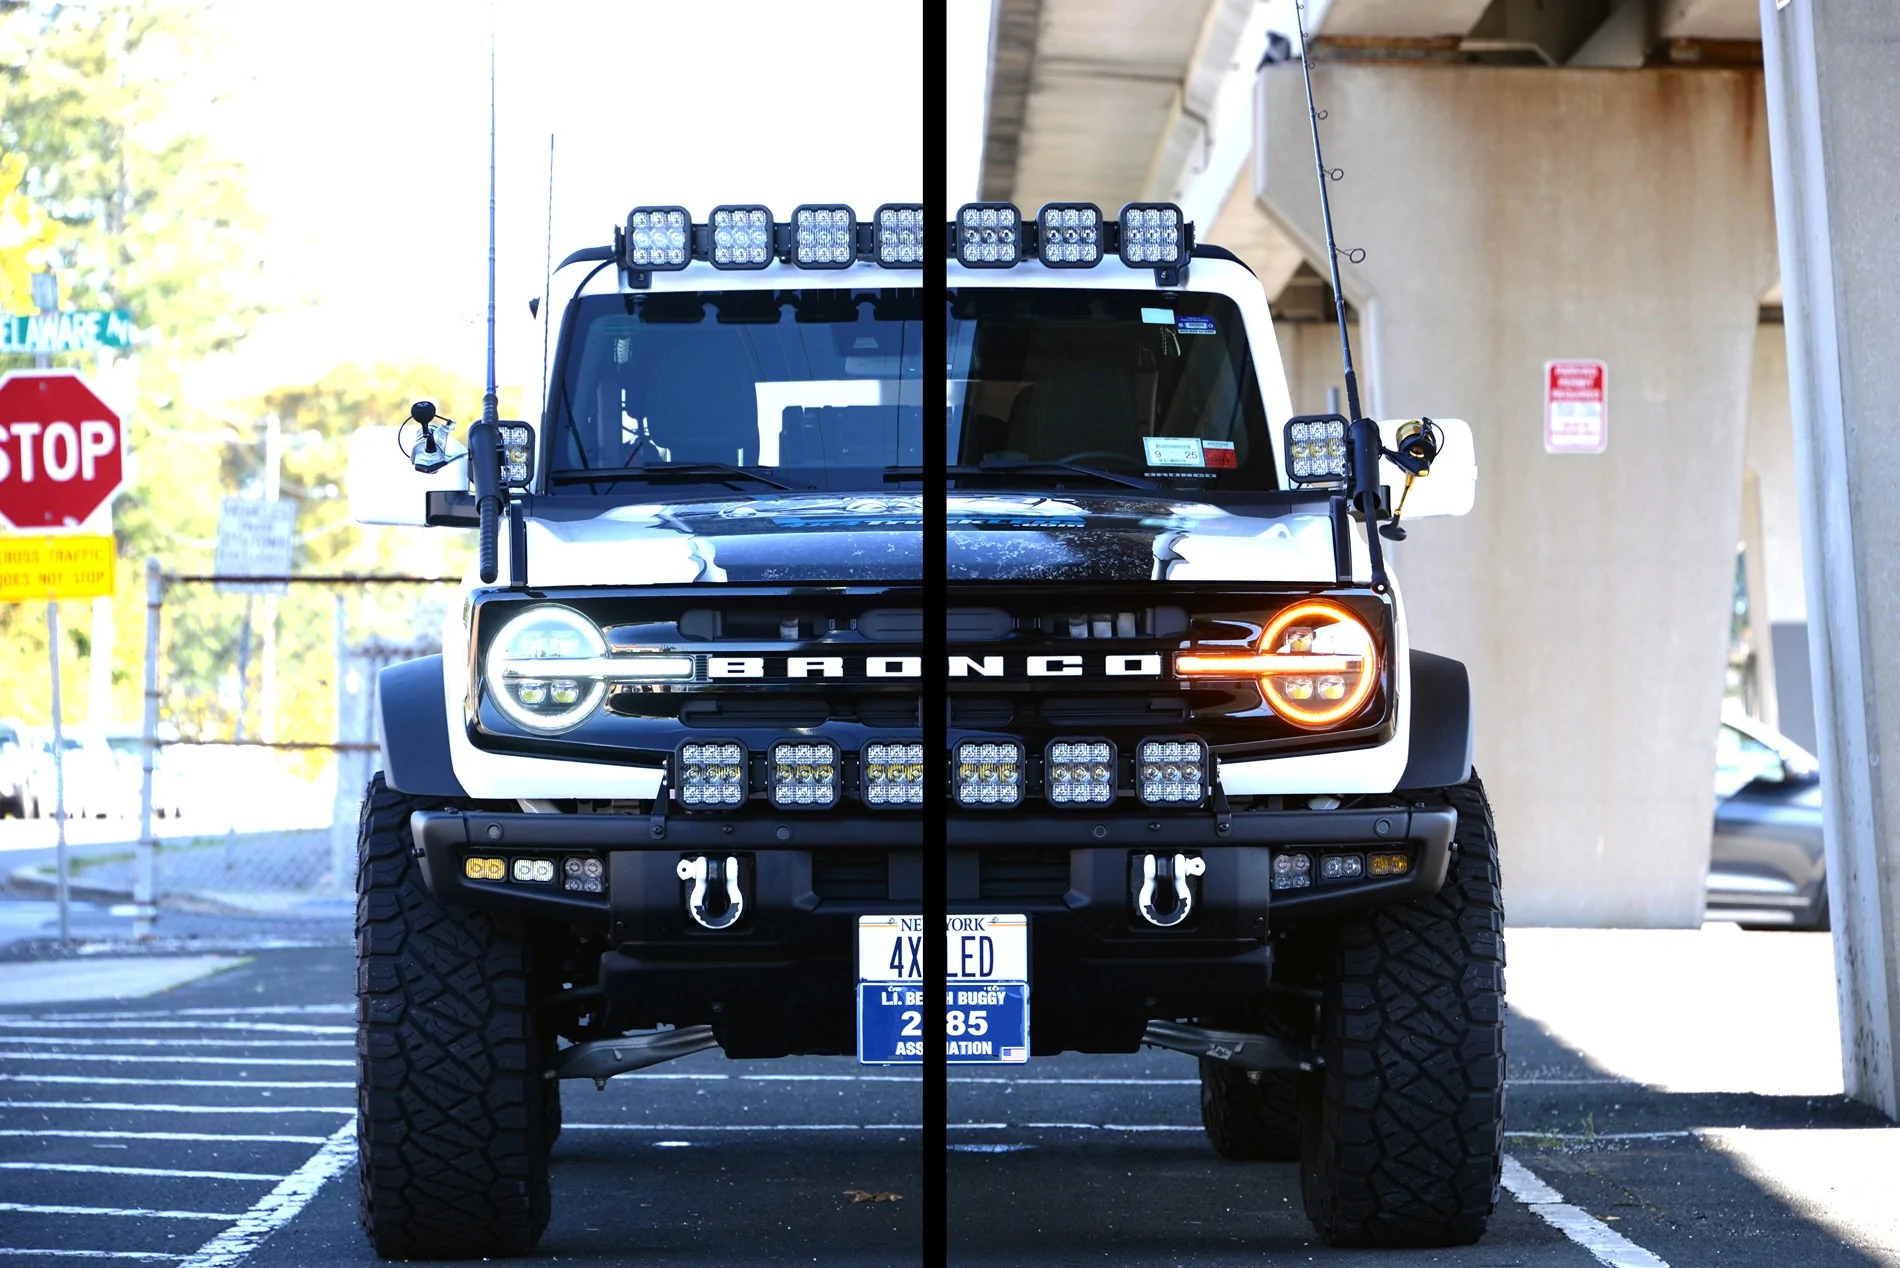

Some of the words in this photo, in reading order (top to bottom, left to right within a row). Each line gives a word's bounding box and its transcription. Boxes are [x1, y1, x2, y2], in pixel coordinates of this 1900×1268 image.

[0, 311, 103, 351] ELAWARE
[1184, 450, 1198, 460] 25
[0, 548, 39, 564] ROSS
[50, 548, 104, 562] TRAFFIC
[39, 571, 62, 586] NOT
[73, 570, 105, 585] STOP
[708, 655, 1162, 678] BRONCO
[889, 935, 994, 978] 4XLED
[881, 991, 903, 1006] L.I.
[905, 991, 954, 1006] BEH
[958, 991, 1006, 1006] BUGGY
[901, 1010, 988, 1037] 285
[895, 1041, 993, 1056] ASSIATION
